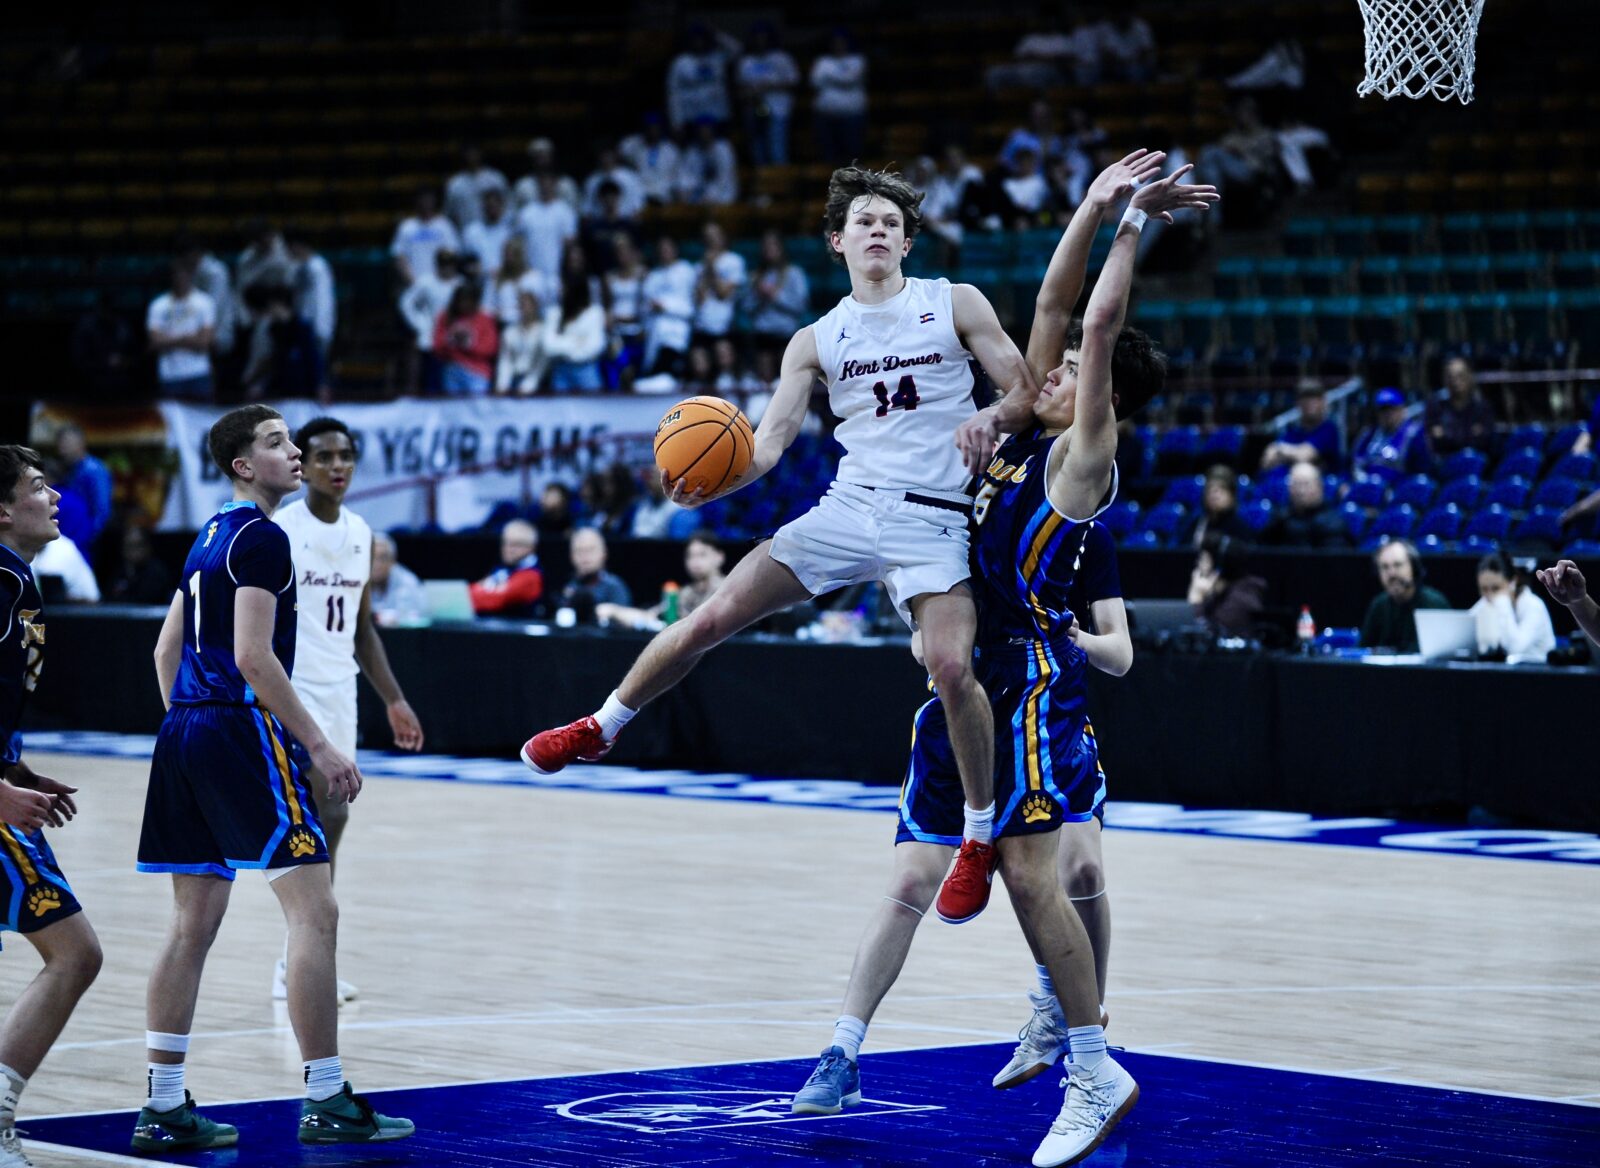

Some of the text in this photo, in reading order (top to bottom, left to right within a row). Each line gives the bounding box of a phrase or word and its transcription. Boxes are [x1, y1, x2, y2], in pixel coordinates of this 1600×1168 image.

[839, 352, 944, 381] Kent Denver
[872, 374, 921, 417] 14
[326, 595, 345, 632] 11
